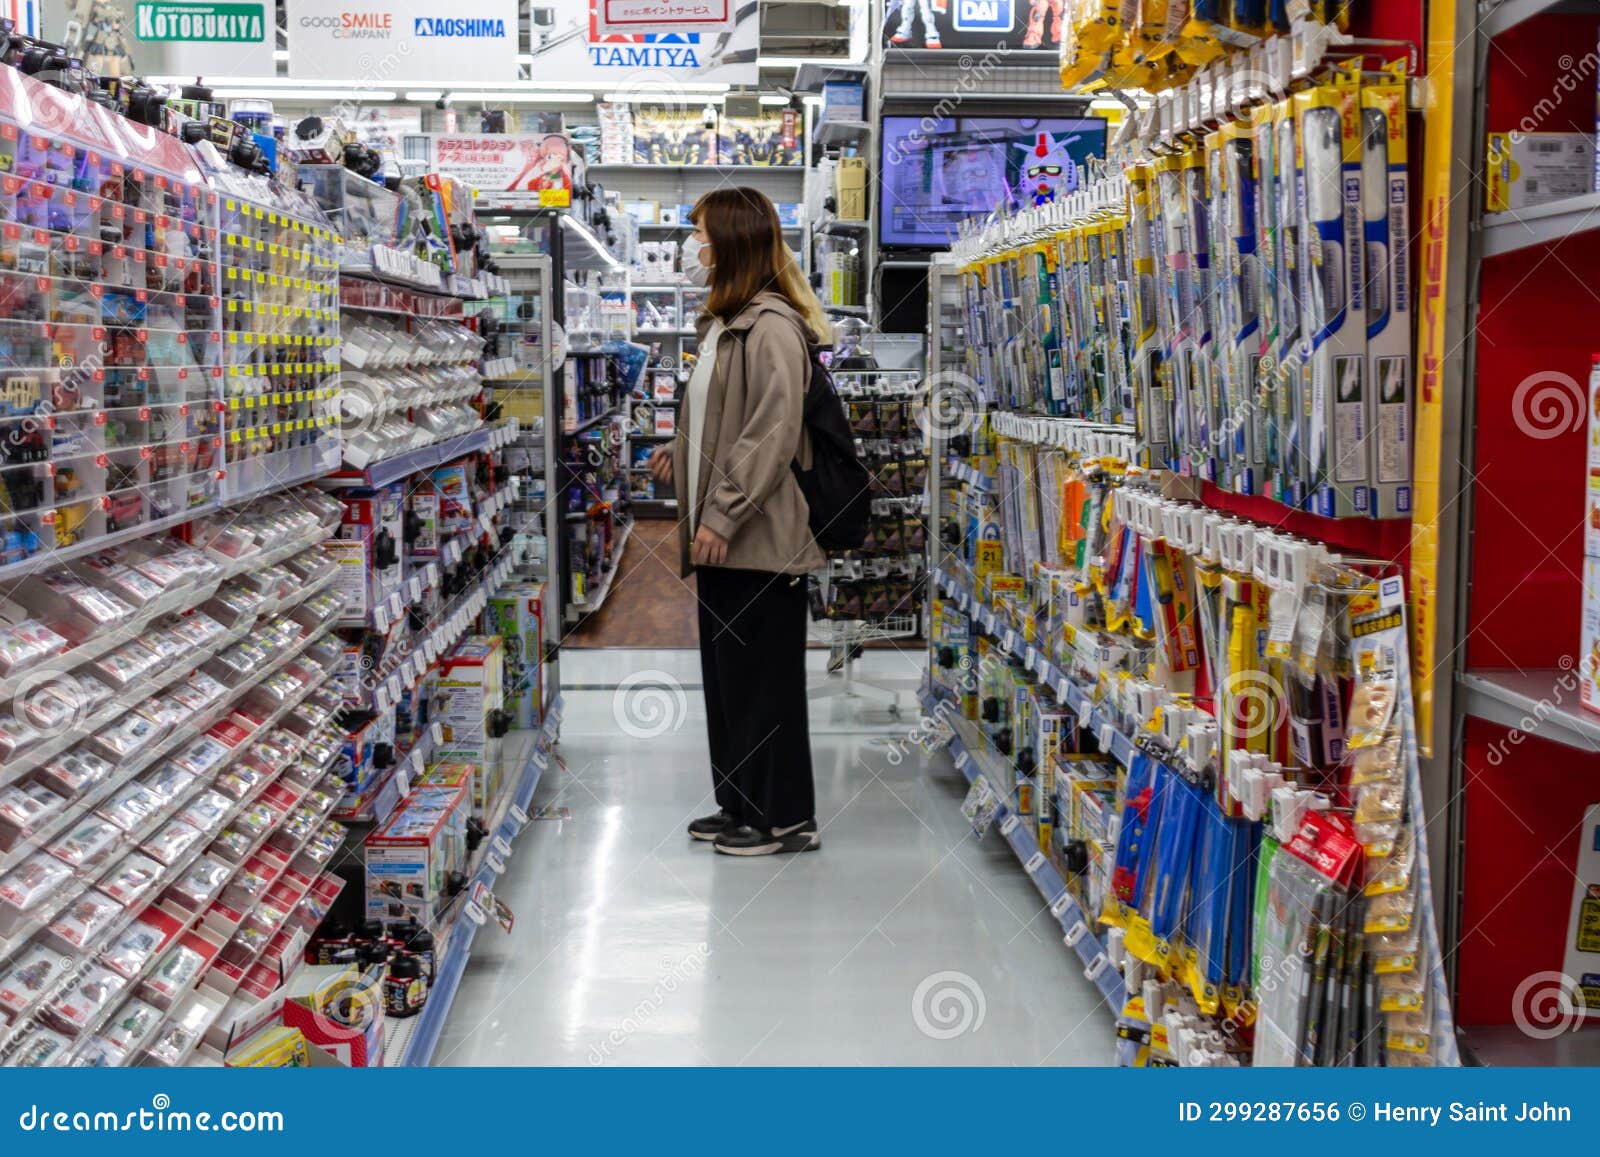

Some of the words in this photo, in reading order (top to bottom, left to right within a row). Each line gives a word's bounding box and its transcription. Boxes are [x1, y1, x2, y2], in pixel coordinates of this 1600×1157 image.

[138, 5, 262, 38] KOTOBUKIYA
[300, 16, 341, 28] GOOD
[342, 13, 392, 29] SMILE
[435, 18, 505, 37] AOSHIMA
[332, 29, 391, 39] COMPANY
[588, 47, 701, 68] TAMIYA
[983, 551, 995, 561] 21
